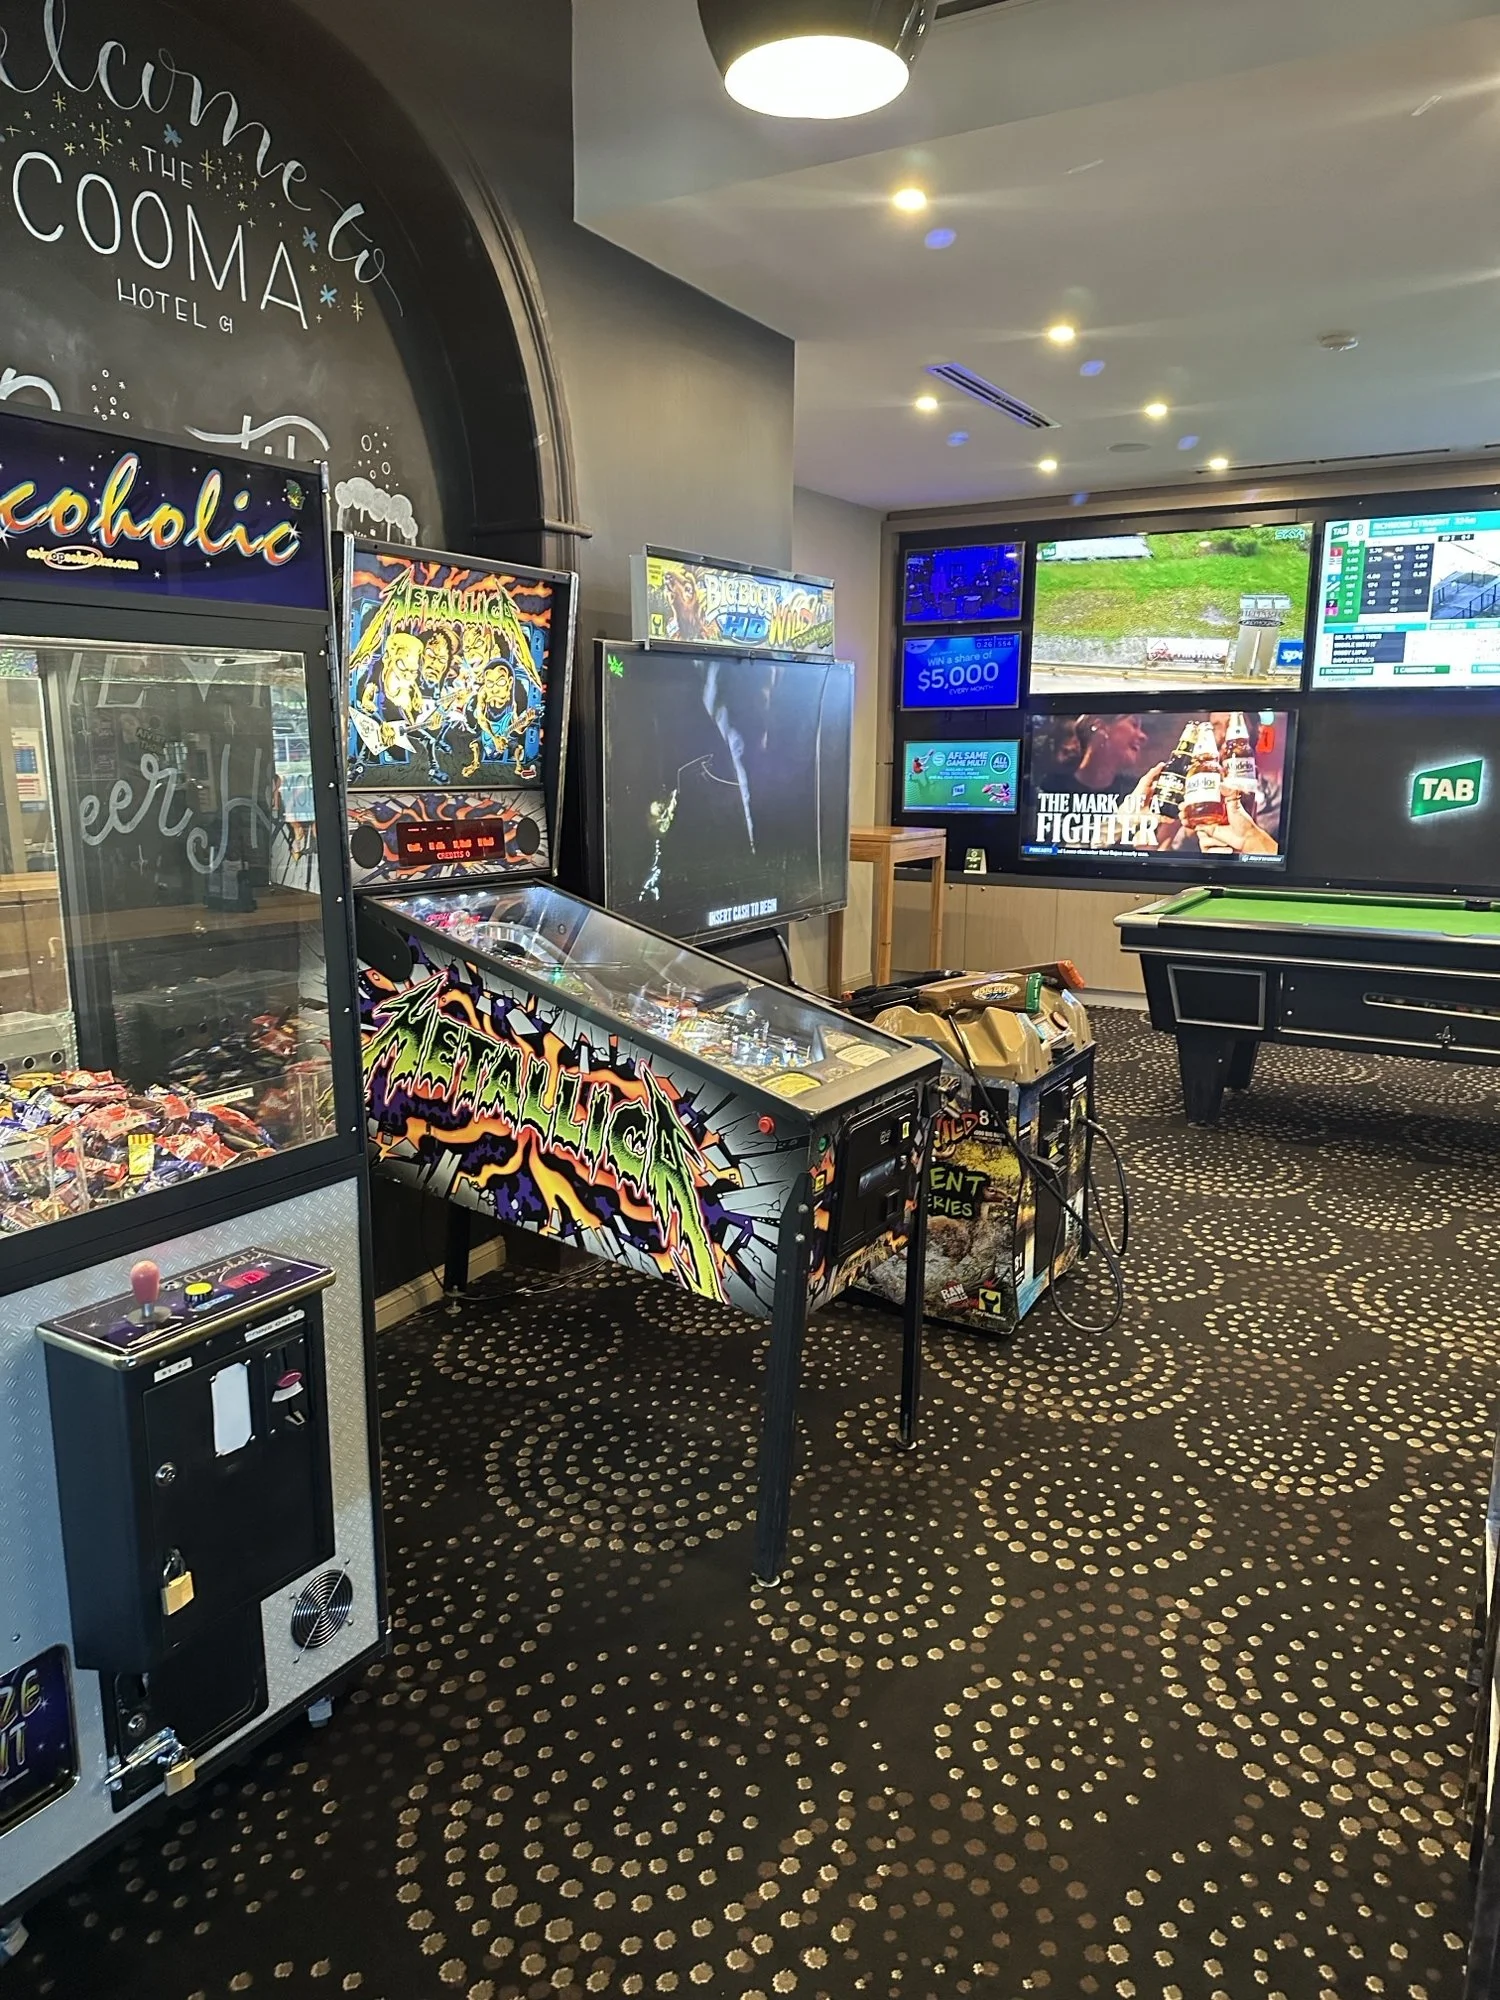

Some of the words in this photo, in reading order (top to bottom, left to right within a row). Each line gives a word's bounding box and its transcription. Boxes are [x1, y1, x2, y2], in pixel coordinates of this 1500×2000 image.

[141, 145, 194, 189] THE
[12, 151, 308, 330] COOMA
[320, 187, 403, 317] to
[116, 278, 207, 329] HOTEL
[704, 573, 738, 610] BIG
[738, 579, 782, 616] BUCK
[349, 563, 543, 694] METALLICA
[722, 614, 768, 642] HD
[927, 657, 945, 667] WIN
[947, 657, 953, 665] a
[954, 651, 980, 664] share
[982, 649, 993, 660] of
[917, 662, 999, 692] $5,000
[948, 687, 969, 696] EVERY
[947, 752, 964, 760] AFL
[964, 751, 989, 759] SAME
[1419, 777, 1475, 801] TAB
[1037, 793, 1070, 813] THE
[1072, 793, 1119, 814] MARK
[1124, 794, 1146, 815] OF
[1149, 794, 1162, 815] A
[1036, 812, 1160, 846] FIGHTER
[436, 851, 464, 860] CREDITS
[708, 907, 732, 927] INSERT
[732, 904, 750, 921] CASH
[750, 902, 759, 917] TO
[759, 898, 777, 915] BEGIN
[362, 968, 729, 1304] METALLICA
[940, 1284, 965, 1299] RAW
[274, 1313, 299, 1327] ONLY
